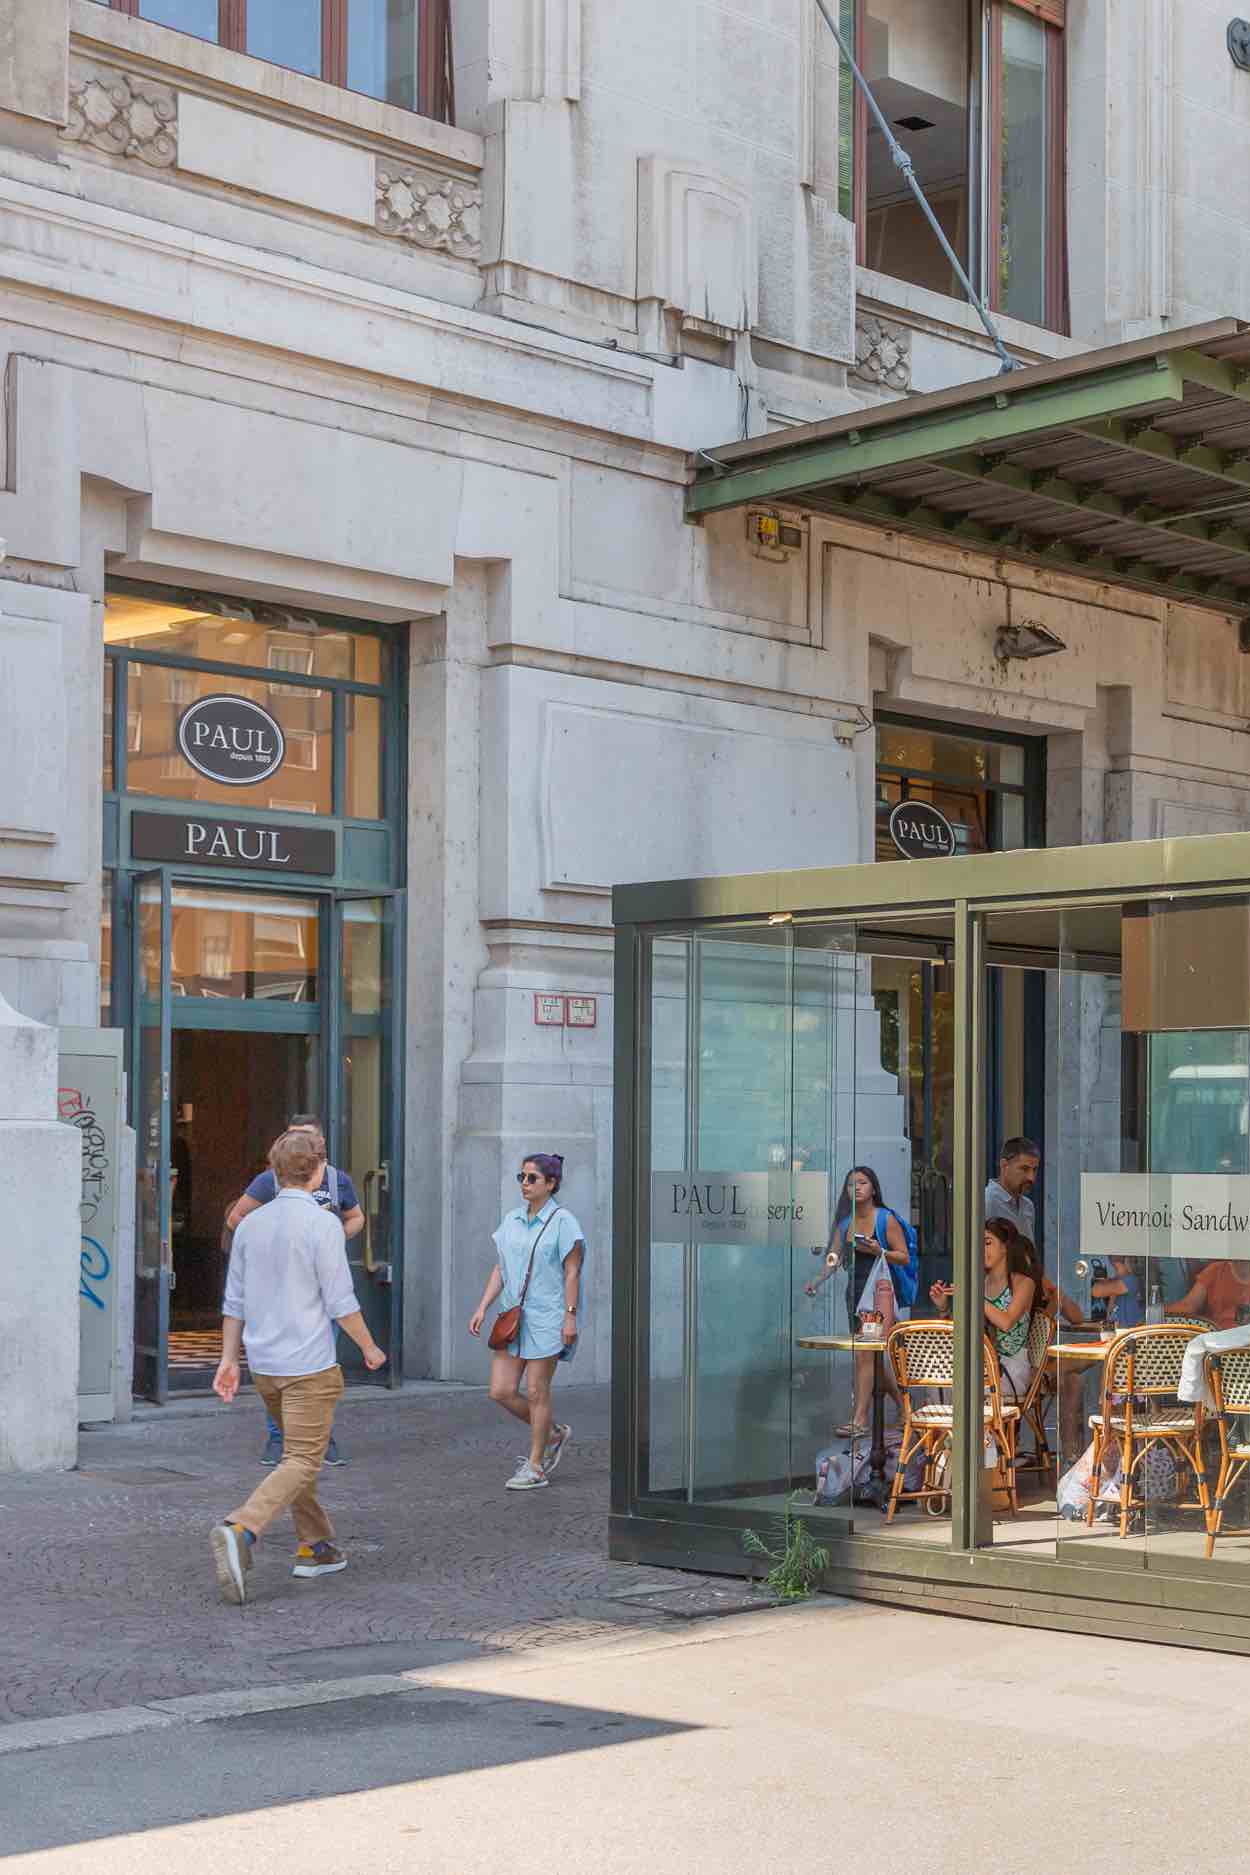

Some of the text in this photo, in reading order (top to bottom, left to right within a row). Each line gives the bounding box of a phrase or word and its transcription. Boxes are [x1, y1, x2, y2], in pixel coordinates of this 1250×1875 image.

[192, 721, 273, 754] PAUL
[184, 822, 291, 863] PAUL
[897, 819, 949, 844] PAUL
[671, 1183, 746, 1216] PAUL
[1095, 1200, 1172, 1228] Viennoi
